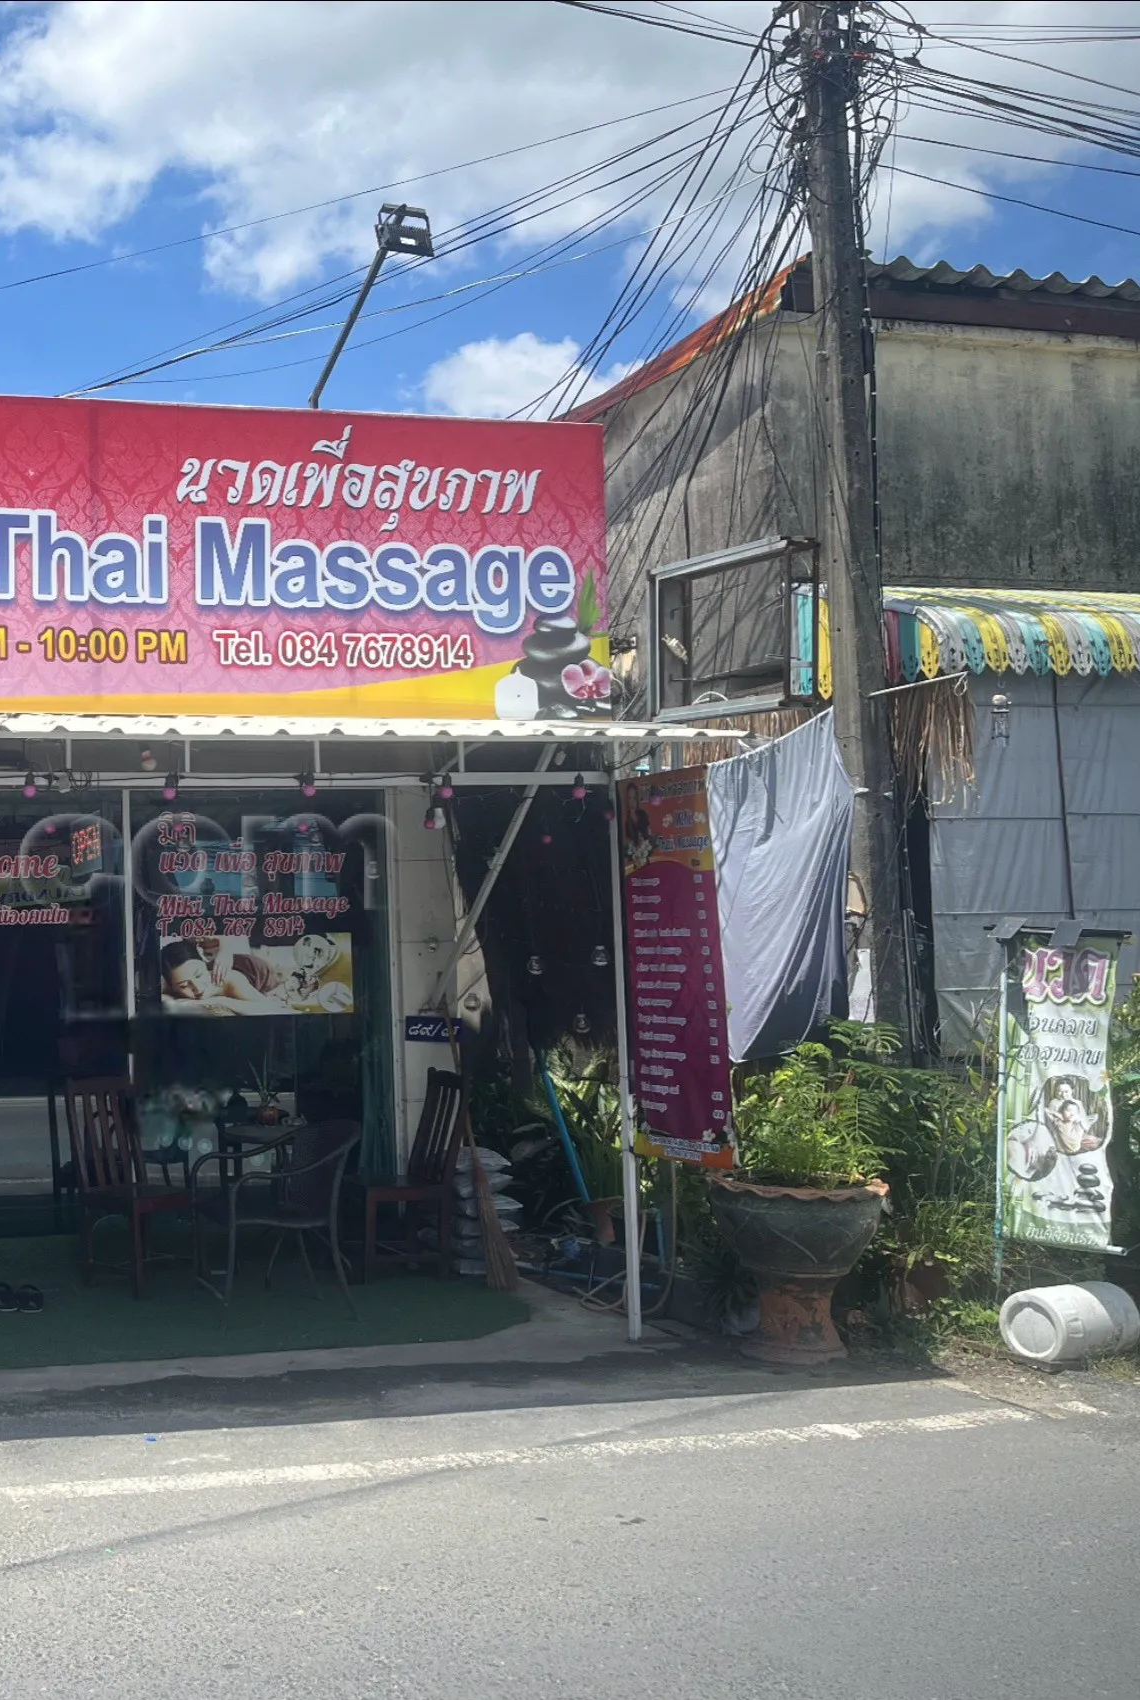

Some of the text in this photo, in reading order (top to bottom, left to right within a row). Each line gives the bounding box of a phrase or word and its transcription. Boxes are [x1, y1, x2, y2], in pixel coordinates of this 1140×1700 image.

[176, 425, 542, 532] นวดเพื่อสุขภาพ
[195, 516, 576, 634] Massage
[38, 628, 127, 663] 10:00
[136, 630, 188, 664] PM
[214, 630, 474, 669] Tel. 084 7678914
[209, 892, 259, 917] Thai
[261, 892, 349, 919] Massage
[222, 917, 255, 938] 767
[264, 916, 305, 938] 8914
